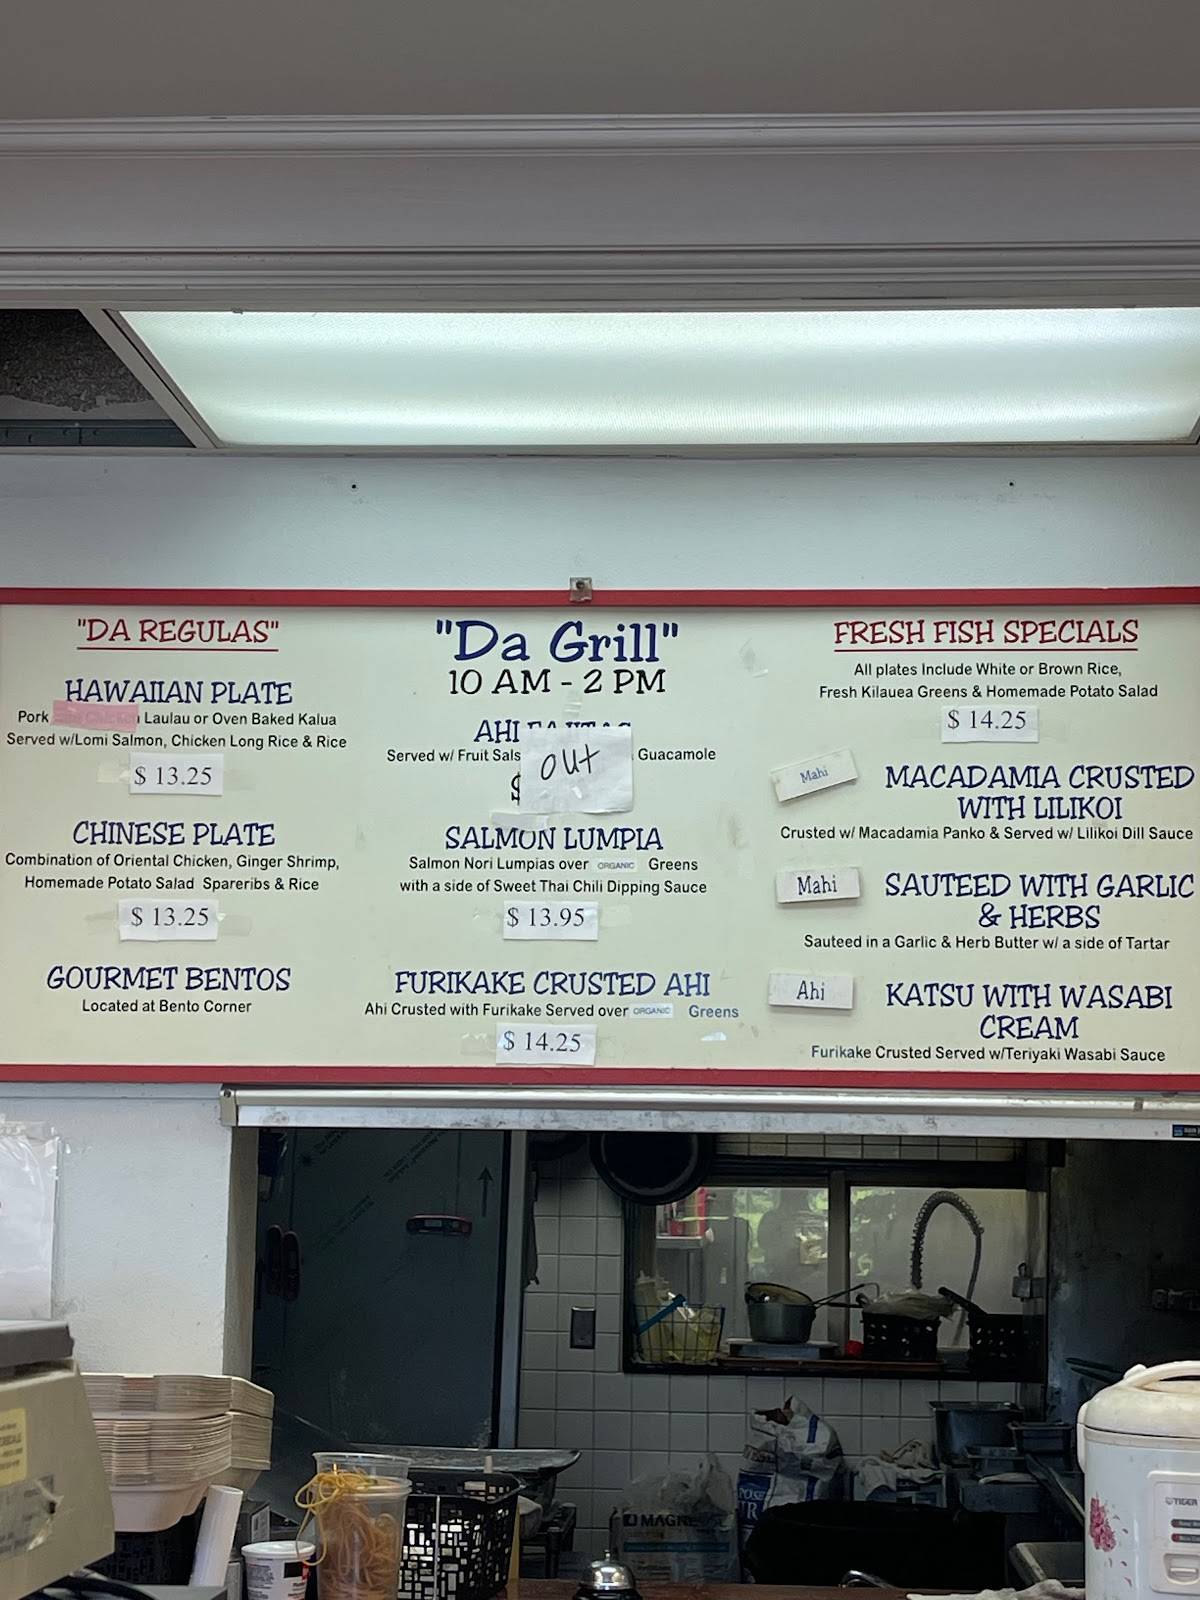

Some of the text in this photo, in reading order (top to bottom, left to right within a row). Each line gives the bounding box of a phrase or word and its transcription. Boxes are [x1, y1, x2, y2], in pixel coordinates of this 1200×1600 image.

[78, 618, 279, 643] "DA REGULAS"
[437, 619, 678, 662] "Da Grill"
[834, 620, 1139, 644] FRESH FISH SPECIALS
[854, 662, 1121, 678] All plates Include White or Brown Rice,
[449, 669, 482, 694] 10
[491, 669, 551, 694] AM
[584, 669, 602, 693] 2
[613, 669, 666, 694] PM
[820, 684, 1157, 698] Fresh Kilauea Greens & Homemade Potato Salad
[65, 679, 292, 705] HAWAIIAN PLATE
[18, 711, 48, 723] Pork
[145, 712, 190, 724] Laulau
[194, 715, 208, 724] or
[213, 712, 247, 724] Oven
[252, 713, 294, 725] Baked
[299, 713, 336, 725] Kalua
[948, 710, 1026, 729] $ 14.25
[7, 731, 346, 750] Served w/Lomi Salmon, Chicken Long Rice & Rice
[474, 719, 520, 743] AHI
[387, 748, 716, 761] Served w/ Fruit Sals Guacamole
[135, 766, 211, 785] $ 13.25
[800, 765, 830, 784] Mahi
[886, 764, 1195, 789] MACADAMIA CRUSTED
[957, 795, 1122, 820] WITH LILIKOI
[73, 820, 275, 846] CHINESE PLATE
[446, 826, 663, 850] SALMON LUMPIA
[781, 826, 1193, 839] Crusted w/ Macadamia Panko & Served w/ Lilikoi Dill Sauce
[6, 853, 339, 871] Combination of Oriental Chicken, Ginger Shrimp,
[409, 857, 459, 869] Salmon
[465, 857, 492, 869] Nori
[498, 857, 554, 872] Lumpias
[559, 860, 589, 870] over
[649, 858, 698, 870] Greens
[25, 876, 319, 892] Homemade Potato Salad Spareribs & Rice
[400, 879, 706, 896] with a side of Sweet Thai Chili Dipping Sauce
[797, 875, 837, 895] Mahi
[886, 873, 1194, 898] SAUTEED WITH GARLIC
[131, 907, 208, 926] $ 13.25
[507, 907, 584, 927] $ 13.95
[979, 902, 1100, 929] & HERBS
[804, 935, 1170, 950] Sauteed in a Garlic & Herb Butter w/ a side of Tartar
[47, 966, 290, 991] GOURMET BENTOS
[395, 971, 710, 997] FURIKAKE CRUSTED AHI
[797, 980, 824, 1000] Ahi
[886, 983, 1172, 1009] KATSU WITH WASABI
[83, 999, 252, 1012] Located at Bento Corner
[365, 1002, 387, 1015] Ahi
[392, 1002, 445, 1015] Crusted
[450, 1003, 478, 1016] with
[483, 1003, 541, 1016] Furikake
[546, 1003, 594, 1016] Served
[598, 1007, 629, 1017] over
[689, 1005, 739, 1017] Greens
[980, 1014, 1079, 1040] CREAM
[504, 1031, 580, 1052] $ 14.25
[812, 1045, 1165, 1063] Furikake Crusted Served w/Teriyaki Wasabi Sauce
